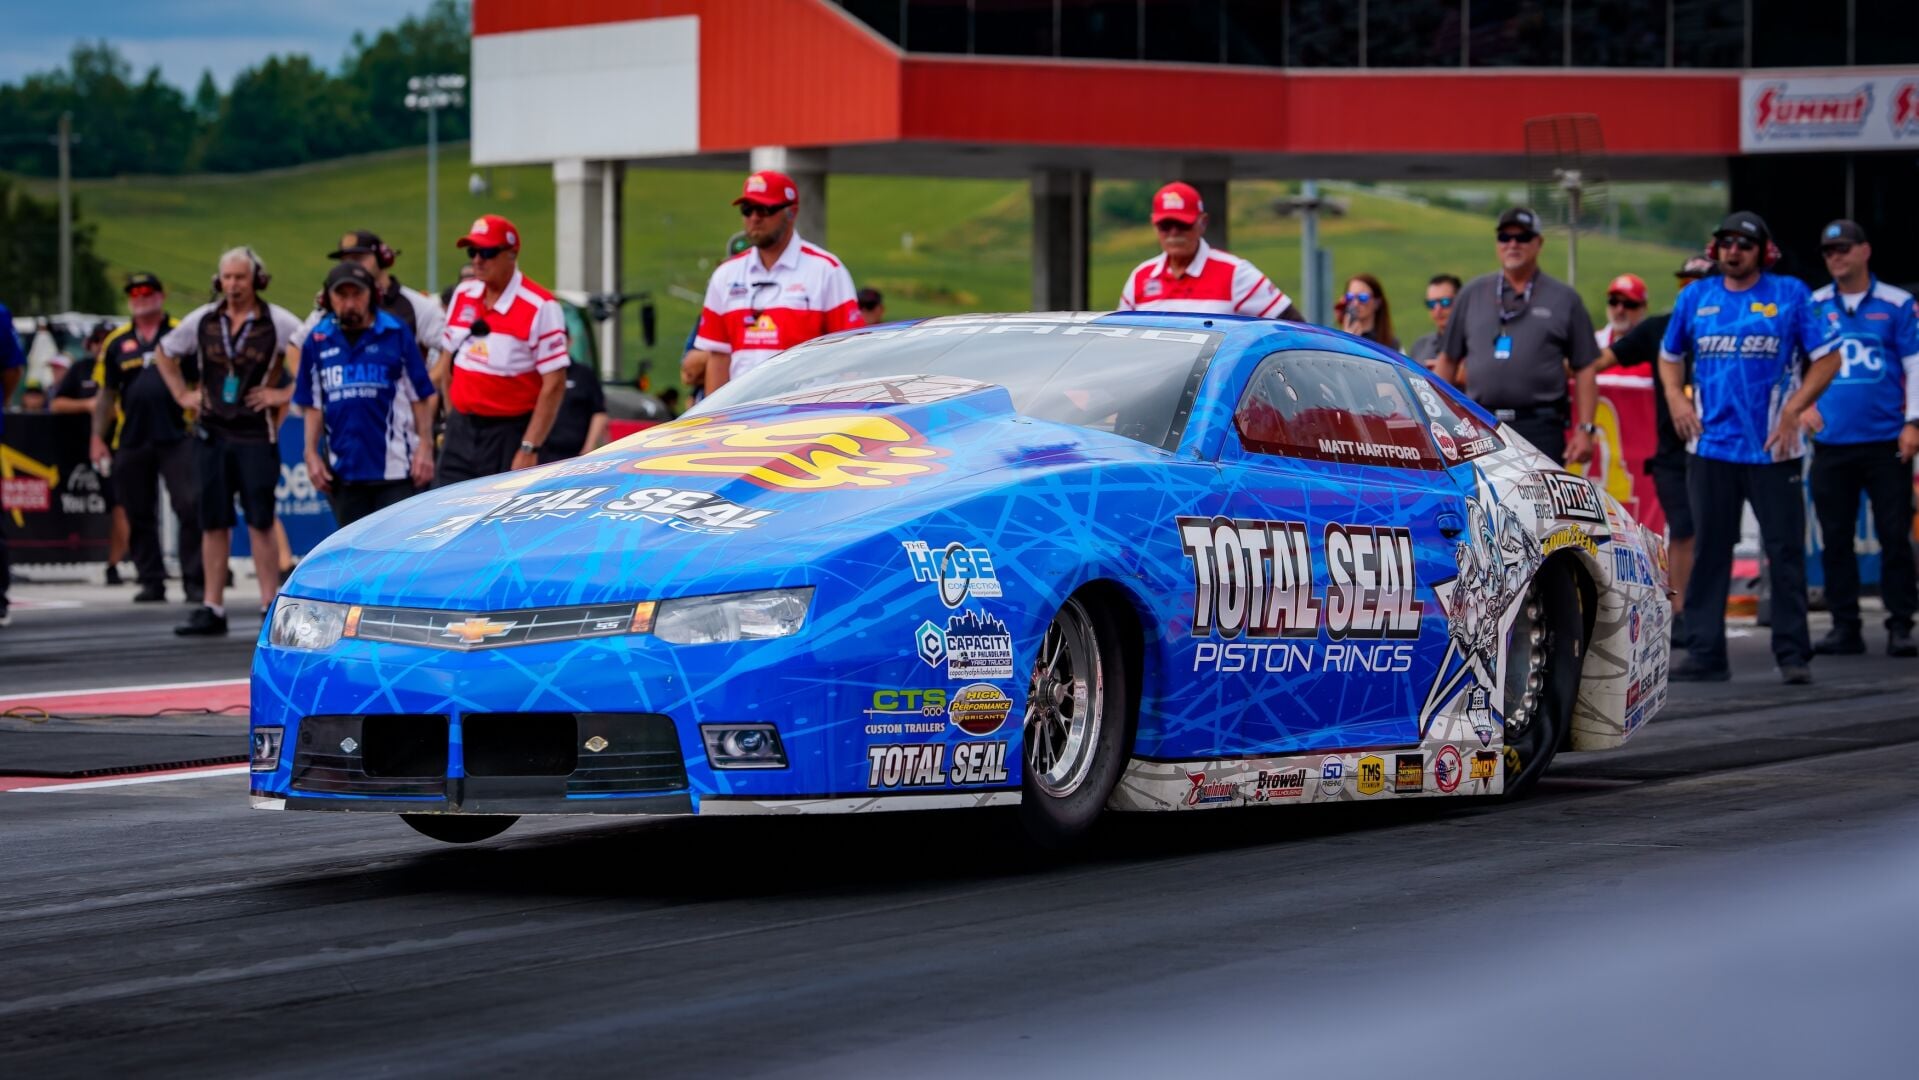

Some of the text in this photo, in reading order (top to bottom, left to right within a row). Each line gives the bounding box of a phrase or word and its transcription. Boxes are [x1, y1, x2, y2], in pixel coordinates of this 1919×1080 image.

[1756, 87, 1867, 129] SUMMIT
[1741, 335, 1779, 353] SEAL
[1420, 391, 1442, 418] 3
[1318, 438, 1420, 461] MATT HARTFORD
[1528, 472, 1542, 482] THE
[1517, 484, 1549, 500] CUTTING
[1543, 472, 1604, 521] ROTTLER
[606, 488, 775, 530] SEAL
[1534, 503, 1553, 520] EDGE
[588, 511, 740, 535] RINGS
[905, 542, 927, 550] THE
[909, 549, 997, 580] HOSE
[947, 582, 1001, 590] CONNECTION
[1181, 524, 1421, 633] TOTAL SEAL
[593, 621, 619, 631] SS
[947, 636, 1010, 651] CAPACITY
[978, 650, 1010, 658] PHILADELPHIA
[1193, 643, 1413, 673] PISTON RINGS
[873, 689, 947, 711] CTS
[966, 690, 1000, 700] HIGH
[952, 701, 1010, 711] PERFORMANCE
[953, 713, 1005, 721] LUBRICANTS
[865, 722, 946, 735] CUSTOM TRAILERS
[868, 743, 1008, 787] TOTAL SEAL
[1362, 763, 1381, 782] TMS
[1257, 769, 1306, 789] Browell
